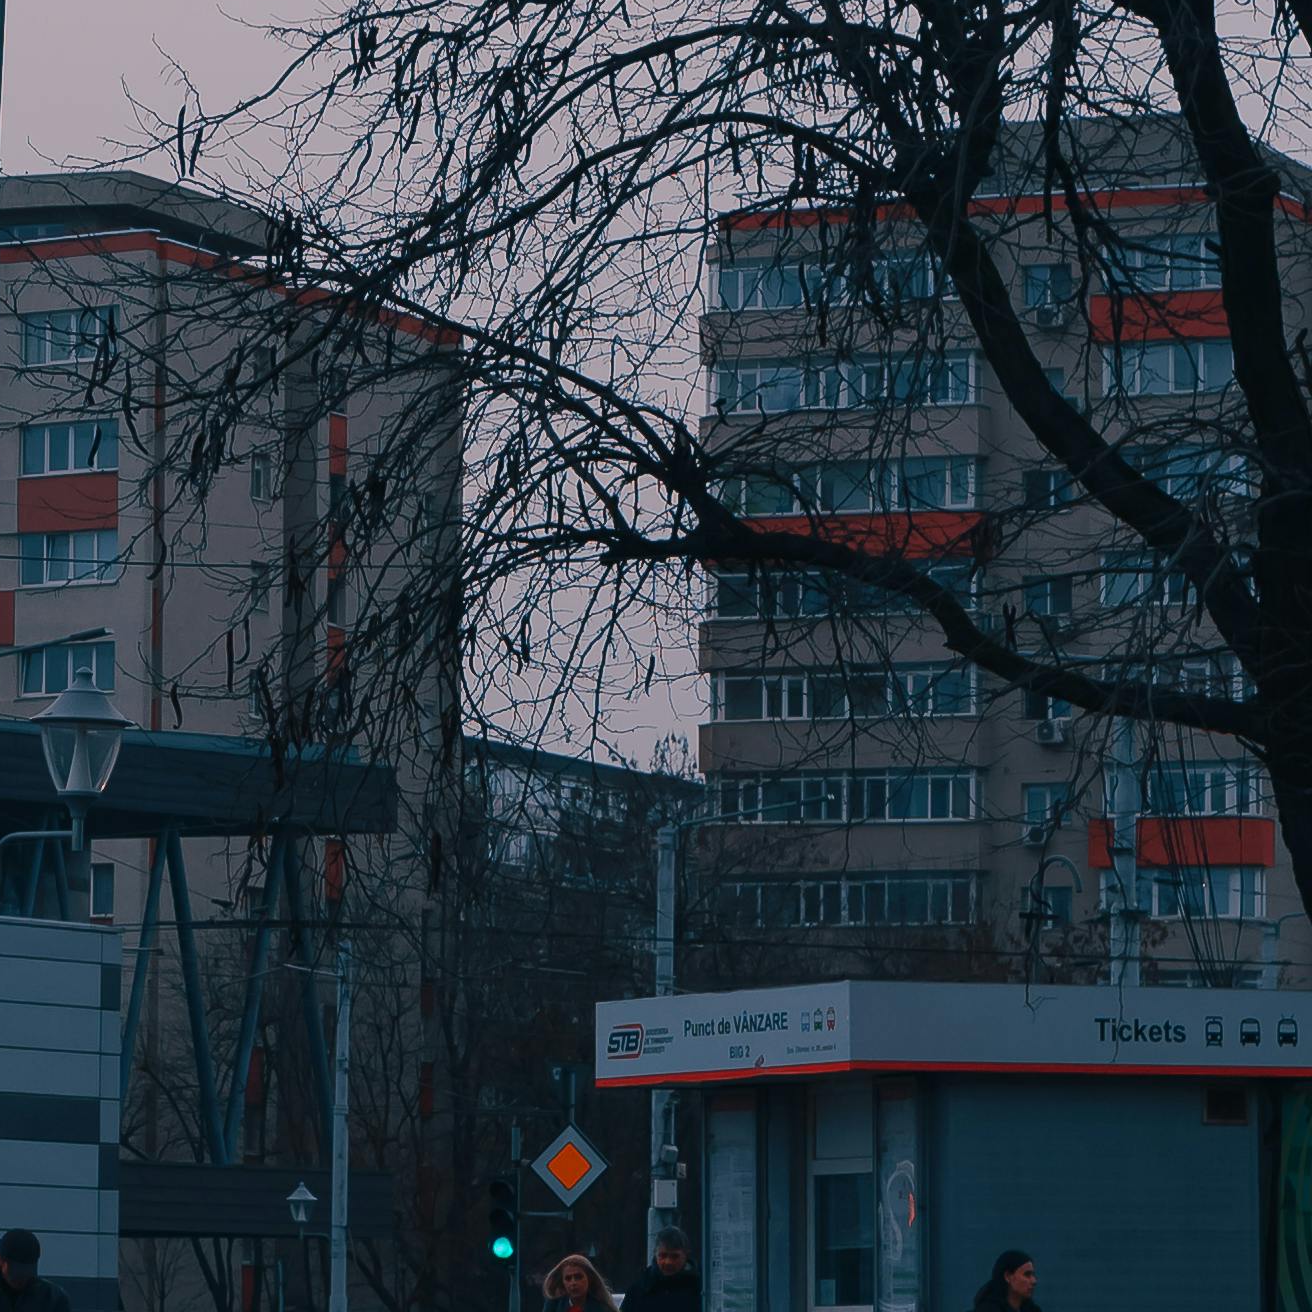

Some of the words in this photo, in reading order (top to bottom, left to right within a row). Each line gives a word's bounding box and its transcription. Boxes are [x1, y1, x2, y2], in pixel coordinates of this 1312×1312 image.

[684, 1019, 715, 1038] Punct
[717, 1016, 731, 1034] de
[732, 1010, 789, 1034] VÂNZARE
[1094, 1017, 1187, 1043] Tickets
[607, 1031, 639, 1055] STB
[745, 1044, 751, 1058] 2
